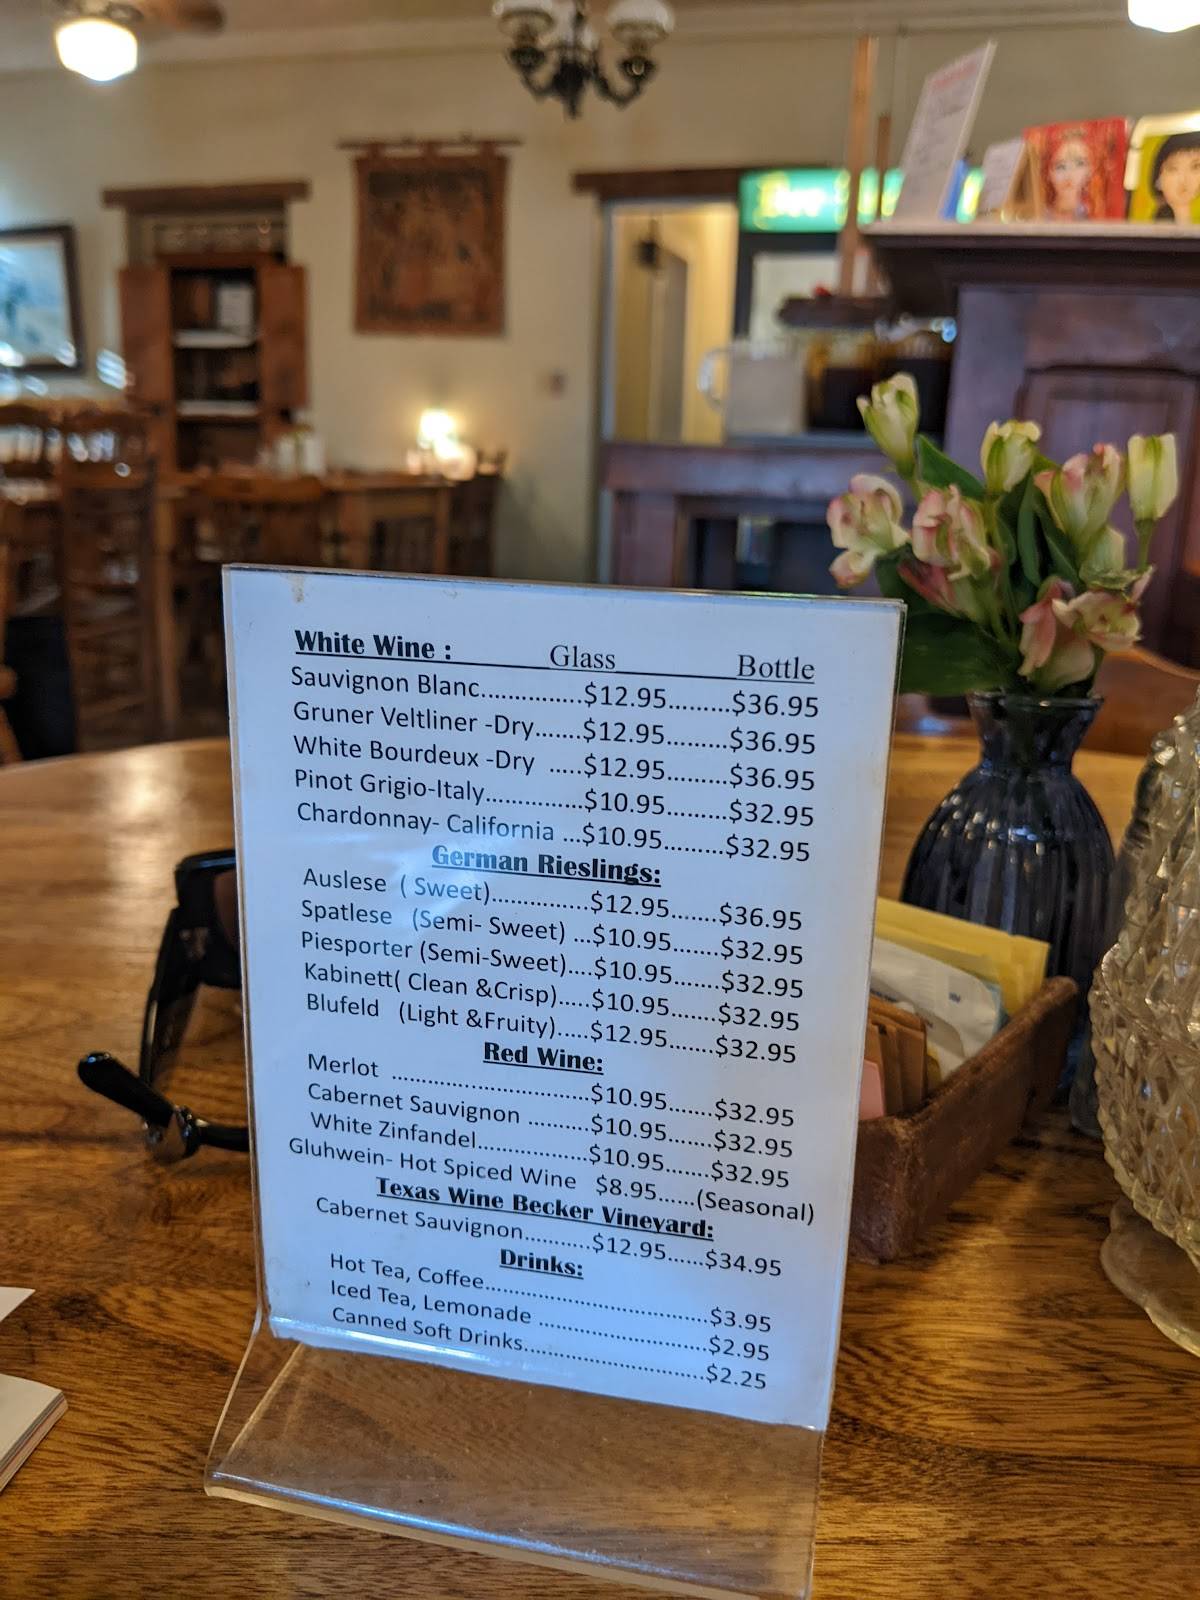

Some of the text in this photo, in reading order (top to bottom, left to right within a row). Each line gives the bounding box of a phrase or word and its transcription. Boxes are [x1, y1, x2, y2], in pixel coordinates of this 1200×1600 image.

[295, 630, 364, 654] White
[550, 645, 616, 670] Glass
[738, 654, 815, 680] Bottle
[291, 667, 818, 718] Sauvignon Blanc $12.95 $36.95
[294, 701, 373, 725] Gruner
[381, 706, 477, 732] Veltliner
[584, 718, 664, 744] $12.95
[730, 727, 816, 754] $36.95
[294, 735, 361, 757] White
[370, 741, 478, 767] Bourdeux
[584, 754, 664, 780] $12.95
[730, 764, 815, 790] $36.95
[295, 770, 814, 826] Pinot Grigio-Italy $10.95 $32.95
[432, 844, 660, 884] German Rieslings:
[447, 814, 555, 841] California
[582, 823, 662, 849] $10.95
[726, 834, 810, 862] $32.95
[303, 868, 386, 892] Auslese
[591, 890, 669, 918] $12.95
[720, 902, 802, 930] $36.95
[302, 900, 392, 925] Spatlese
[489, 916, 565, 944] Sweet)
[593, 924, 671, 951] $10.95
[720, 936, 803, 964] $32.95
[302, 932, 803, 998] Piesporter (Semi-Sweet) $10.95 $32.95
[307, 994, 379, 1017] Blufeld
[399, 1001, 458, 1028] (Light
[590, 1020, 667, 1048] $12.95
[716, 1034, 796, 1063] $32.95
[408, 973, 467, 996] Clean
[592, 988, 669, 1016] $10.95
[718, 1002, 799, 1031] $32.95
[484, 1042, 603, 1072] Red Wine:
[308, 1054, 794, 1127] Merlot $10.95 $32.95
[308, 1083, 792, 1158] Cabernet Sauvignon $10.95 $32.95
[310, 1112, 789, 1188] White Zinfandel $10.95 $32.95
[376, 1177, 714, 1238] Texas Wine Becker Vineyard:
[400, 1153, 436, 1173] Hot
[444, 1158, 512, 1182] Spiced
[520, 1167, 576, 1189] Wine
[596, 1174, 656, 1201] $8.95
[696, 1188, 814, 1226] (Seasonal)
[316, 1196, 782, 1276] Cabernet Sauvignon $12.95 $34.95
[500, 1248, 584, 1276] Drinks:
[330, 1254, 771, 1332] Hot Tea, Coffee $3.95
[330, 1281, 770, 1361] Iced Tea, Lemonade $2.95
[332, 1307, 766, 1390] Canned Soft Drinks $2.25
